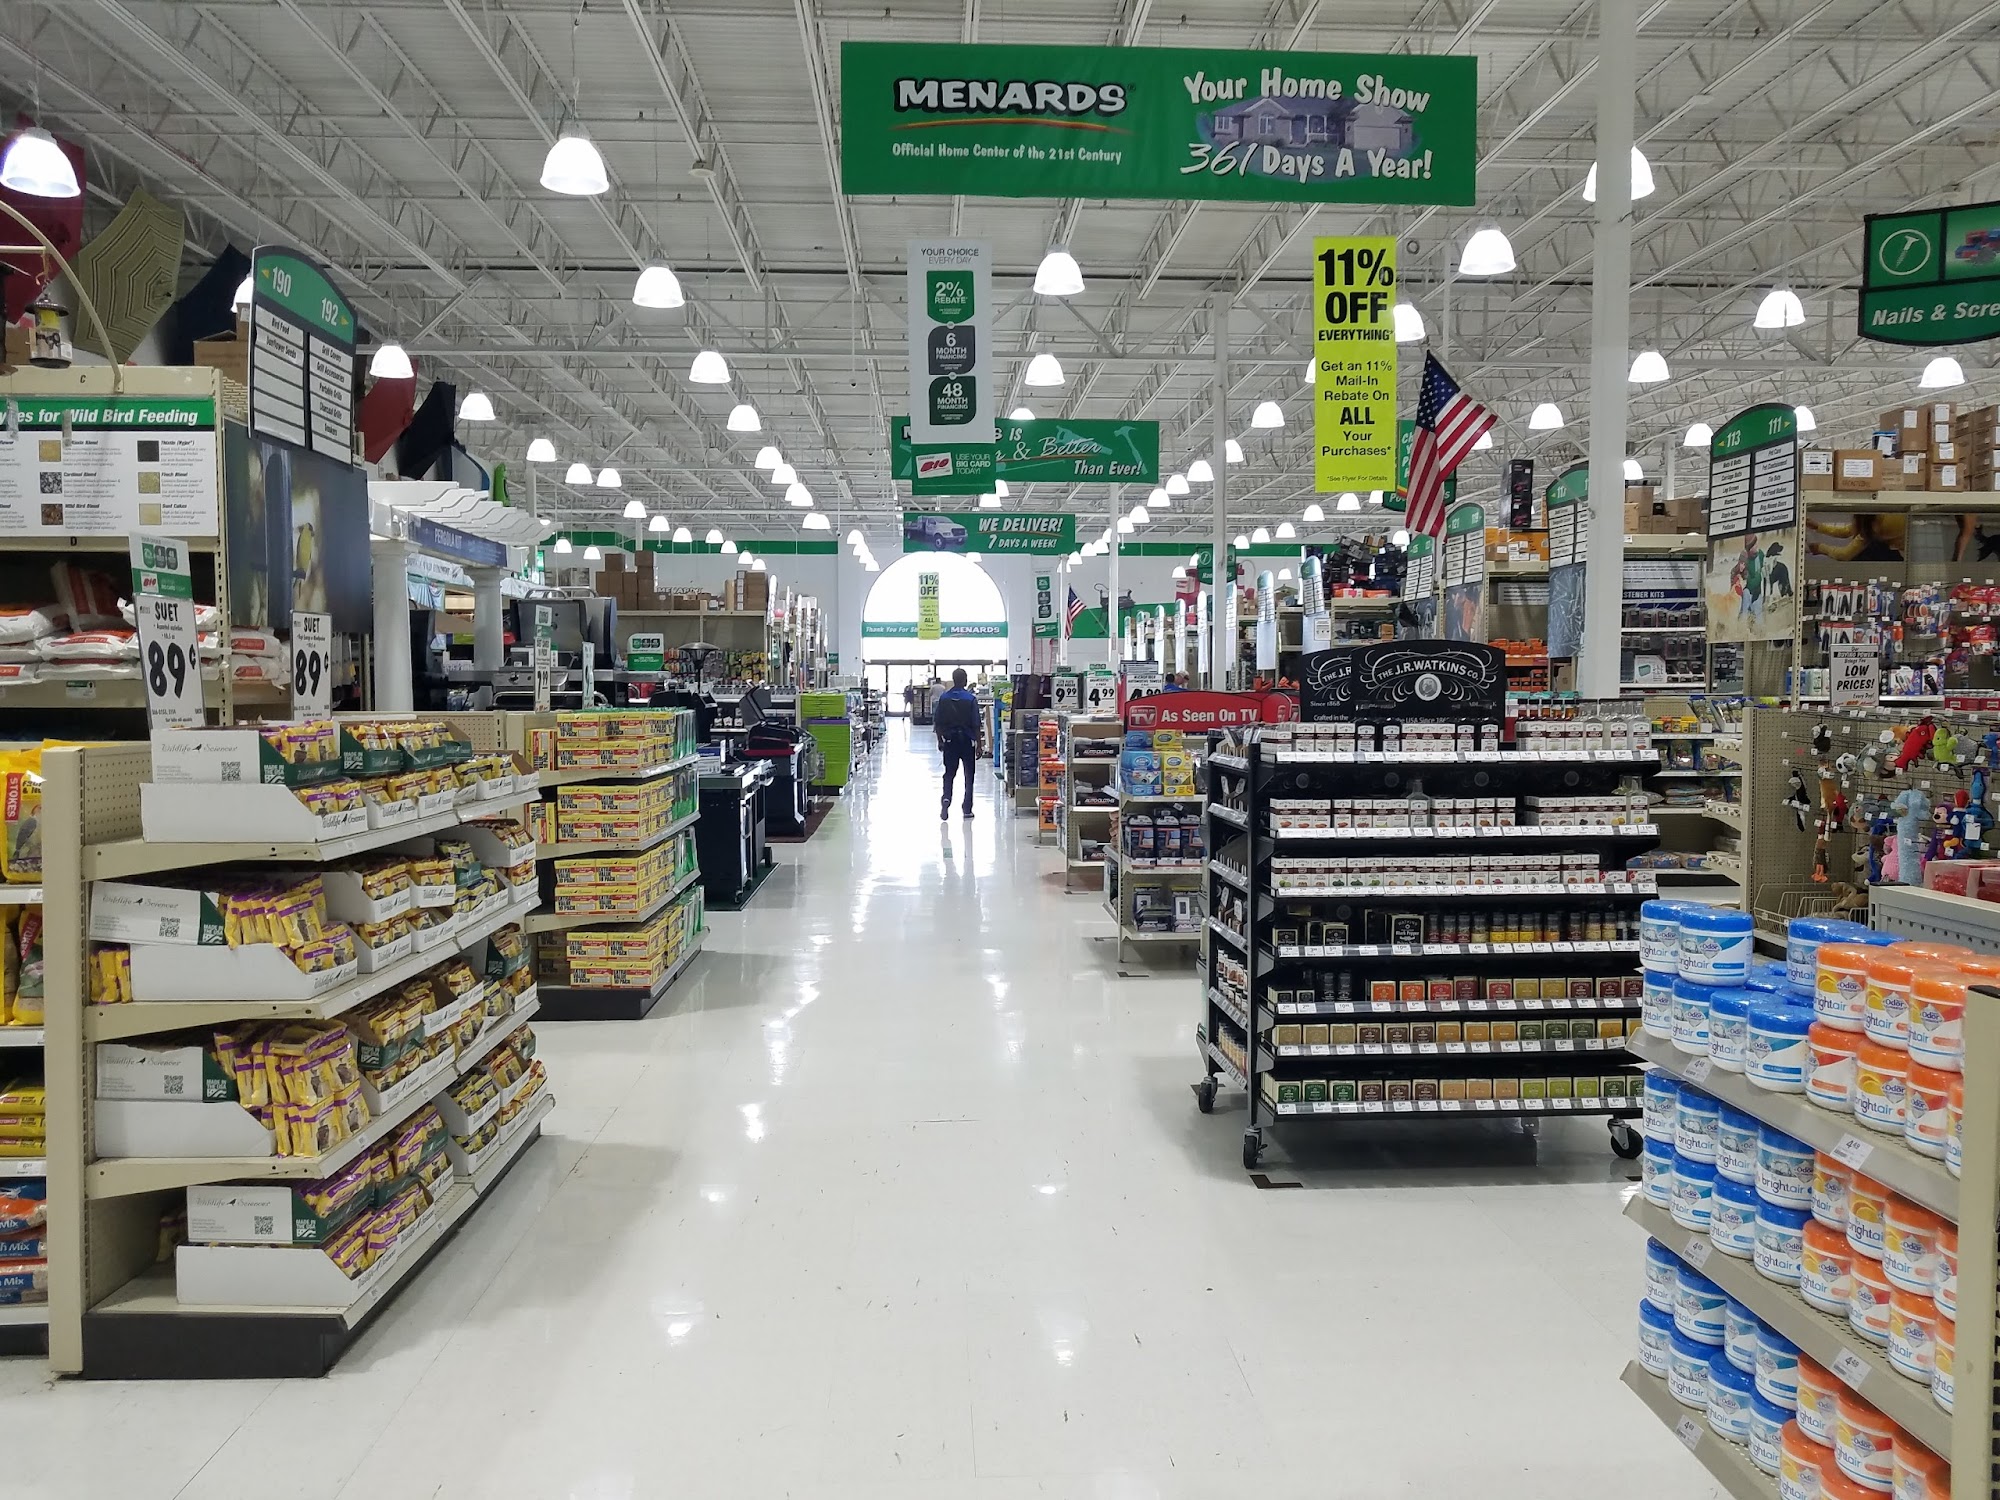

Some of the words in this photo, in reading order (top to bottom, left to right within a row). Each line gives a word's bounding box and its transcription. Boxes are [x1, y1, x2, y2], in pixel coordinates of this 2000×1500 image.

[895, 79, 1127, 115] MENARDS
[1183, 71, 1247, 104] Your
[1260, 67, 1342, 100] Home
[1354, 74, 1431, 113] Show
[892, 143, 934, 157] Official
[938, 144, 969, 157] Home
[973, 144, 1009, 158] Center
[1013, 145, 1026, 159] of
[1028, 146, 1045, 160] the
[1048, 147, 1075, 160] 21st
[1078, 147, 1122, 164] Century
[1180, 141, 1259, 176] 361
[1262, 145, 1324, 183] Days
[1335, 147, 1355, 177] A
[1367, 147, 1433, 179] Year!
[921, 248, 945, 256] YOUR
[947, 248, 980, 257] CHOICE
[1318, 248, 1394, 287] 11%
[272, 266, 291, 297] 190
[935, 281, 964, 297] 2%
[321, 297, 339, 326] 192
[1325, 291, 1388, 324] OFF
[1872, 306, 1925, 327] Nails
[1931, 304, 1947, 321] &
[271, 317, 280, 331] Bird
[280, 320, 290, 335] Food
[945, 333, 957, 347] 6
[266, 336, 285, 354] Sunflower
[285, 345, 297, 359] Seeds
[936, 347, 967, 355] MONTH
[1321, 361, 1343, 372] Get
[1347, 363, 1362, 371] an
[1366, 361, 1392, 372] 11%
[1336, 376, 1378, 386] Mail-In
[942, 383, 963, 397] 48
[1324, 391, 1369, 401] Rebate
[1372, 391, 1389, 401] On
[937, 397, 968, 405] MONTH
[0, 412, 33, 426] yes
[38, 409, 60, 423] for
[102, 409, 134, 423] Bird
[138, 409, 198, 426] Feeding
[1340, 407, 1375, 425] ALL
[1768, 416, 1782, 435] 111
[1009, 428, 1023, 441] IS
[1343, 431, 1372, 441] Your
[1727, 430, 1741, 448] 113
[1013, 441, 1031, 460] &
[1038, 436, 1102, 456] Better
[1074, 460, 1103, 476] Than
[1109, 461, 1142, 476] Ever!
[978, 518, 998, 532] WE
[1002, 518, 1063, 532] DELIVER!
[434, 527, 455, 547] PERGOLA
[988, 535, 997, 549] 7
[998, 538, 1020, 548] DAYS
[1021, 539, 1028, 548] A
[1030, 538, 1056, 548] WEEK!
[918, 574, 939, 585] 11%
[920, 586, 938, 595] OFF
[155, 601, 179, 622] SUET
[303, 617, 320, 633] SUET
[1322, 672, 1337, 683] THE
[1377, 668, 1394, 681] THE
[1467, 669, 1479, 681] CO.
[1845, 665, 1869, 677] LOW
[1837, 679, 1875, 690] PRICES!
[1131, 713, 1155, 725] TV
[1161, 709, 1178, 722] As
[1182, 709, 1215, 722] Seen
[1219, 709, 1236, 722] On
[1240, 709, 1258, 722] TV
[161, 744, 191, 754] Wildlife
[7, 777, 19, 818] STOKES
[103, 896, 132, 906] Wildlife
[1679, 1134, 1714, 1149] brightair
[1762, 1178, 1804, 1193] brightair
[9, 1242, 30, 1251] Mix
[1902, 1241, 1922, 1250] Odor
[4, 1277, 24, 1285] Mix
